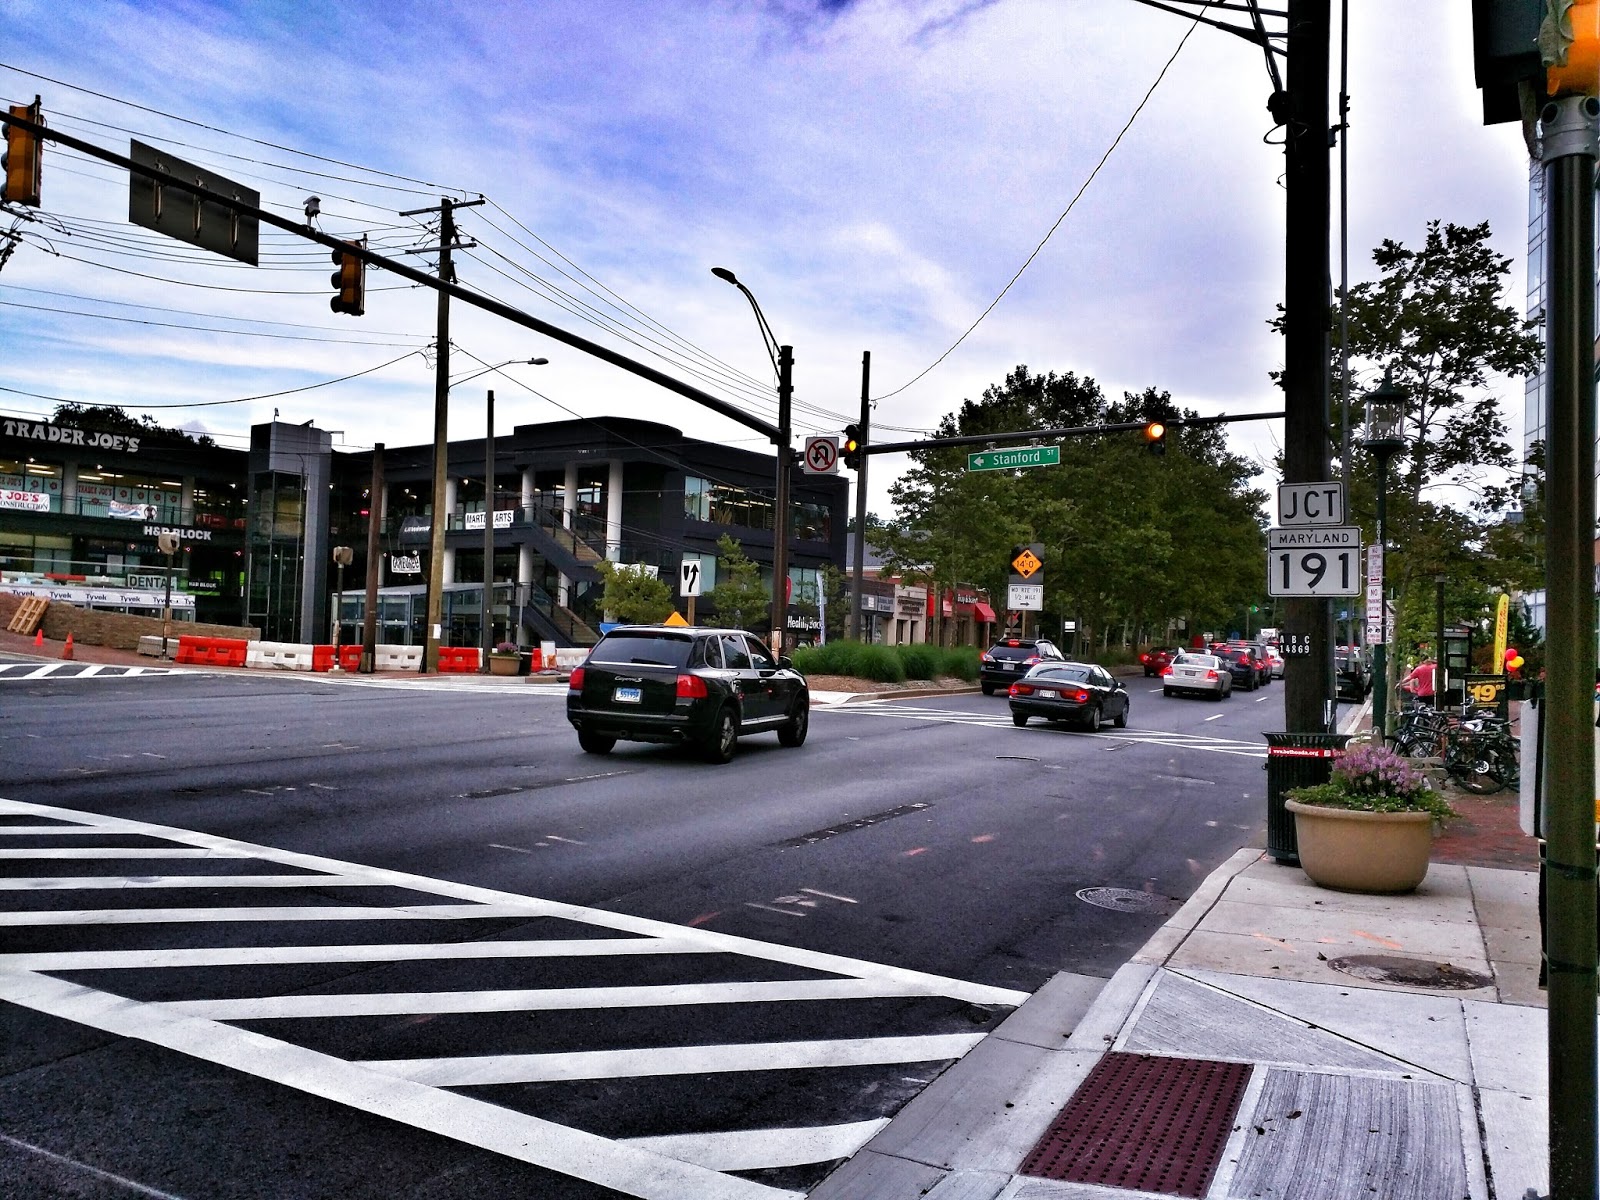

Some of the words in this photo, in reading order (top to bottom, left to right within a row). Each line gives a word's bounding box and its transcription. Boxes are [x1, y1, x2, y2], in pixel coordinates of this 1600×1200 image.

[4, 420, 85, 446] TRADER
[87, 432, 140, 453] JOE'S
[993, 451, 1040, 465] Stanford
[6, 491, 40, 502] JOE'S
[0, 500, 49, 510] ONSTRUCTION
[1284, 490, 1337, 519] JCT
[495, 512, 512, 523] ARTS
[174, 529, 212, 540] BLOCK
[1280, 533, 1349, 543] MARYLAND
[1280, 553, 1349, 589] 191
[12, 589, 35, 597] Tyvek
[50, 591, 72, 599] Tyvek
[86, 593, 107, 601] Tyvek
[120, 595, 141, 603] Tyvek
[1280, 645, 1310, 654] 14869
